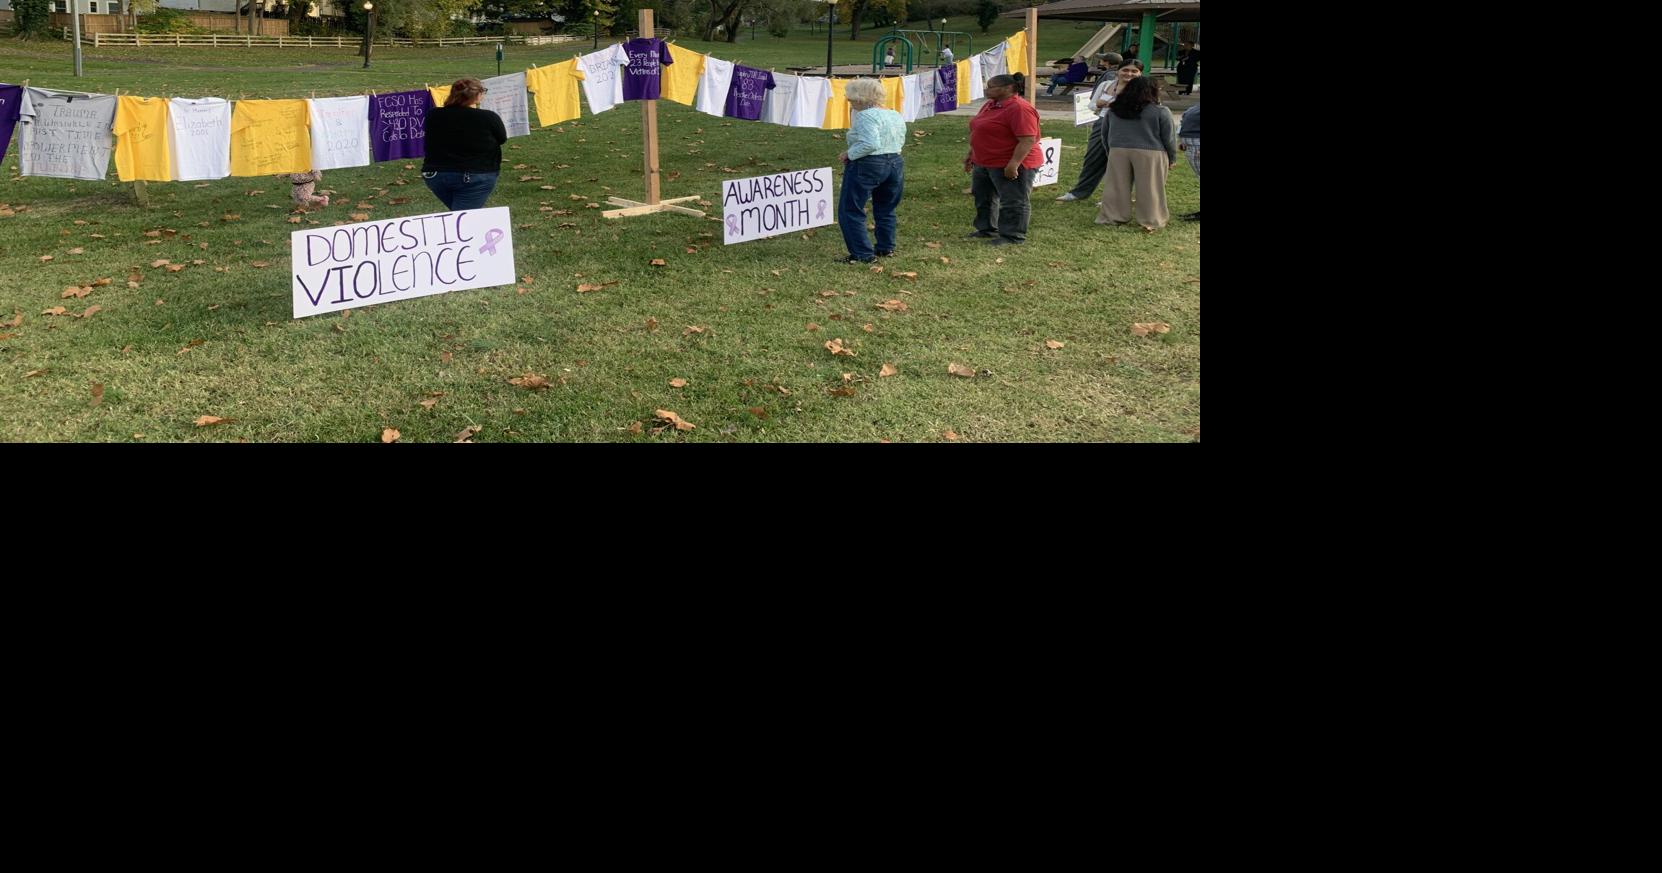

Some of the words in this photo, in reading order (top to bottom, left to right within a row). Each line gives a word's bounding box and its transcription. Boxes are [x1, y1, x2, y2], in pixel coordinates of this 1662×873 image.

[377, 95, 405, 108] FCSO
[408, 94, 424, 105] Has
[409, 117, 426, 128] DV
[724, 169, 824, 207] AWARENESS
[741, 198, 809, 236] MONTH
[306, 212, 474, 267] DOMESTIC
[296, 245, 477, 307] VIOLENCE
